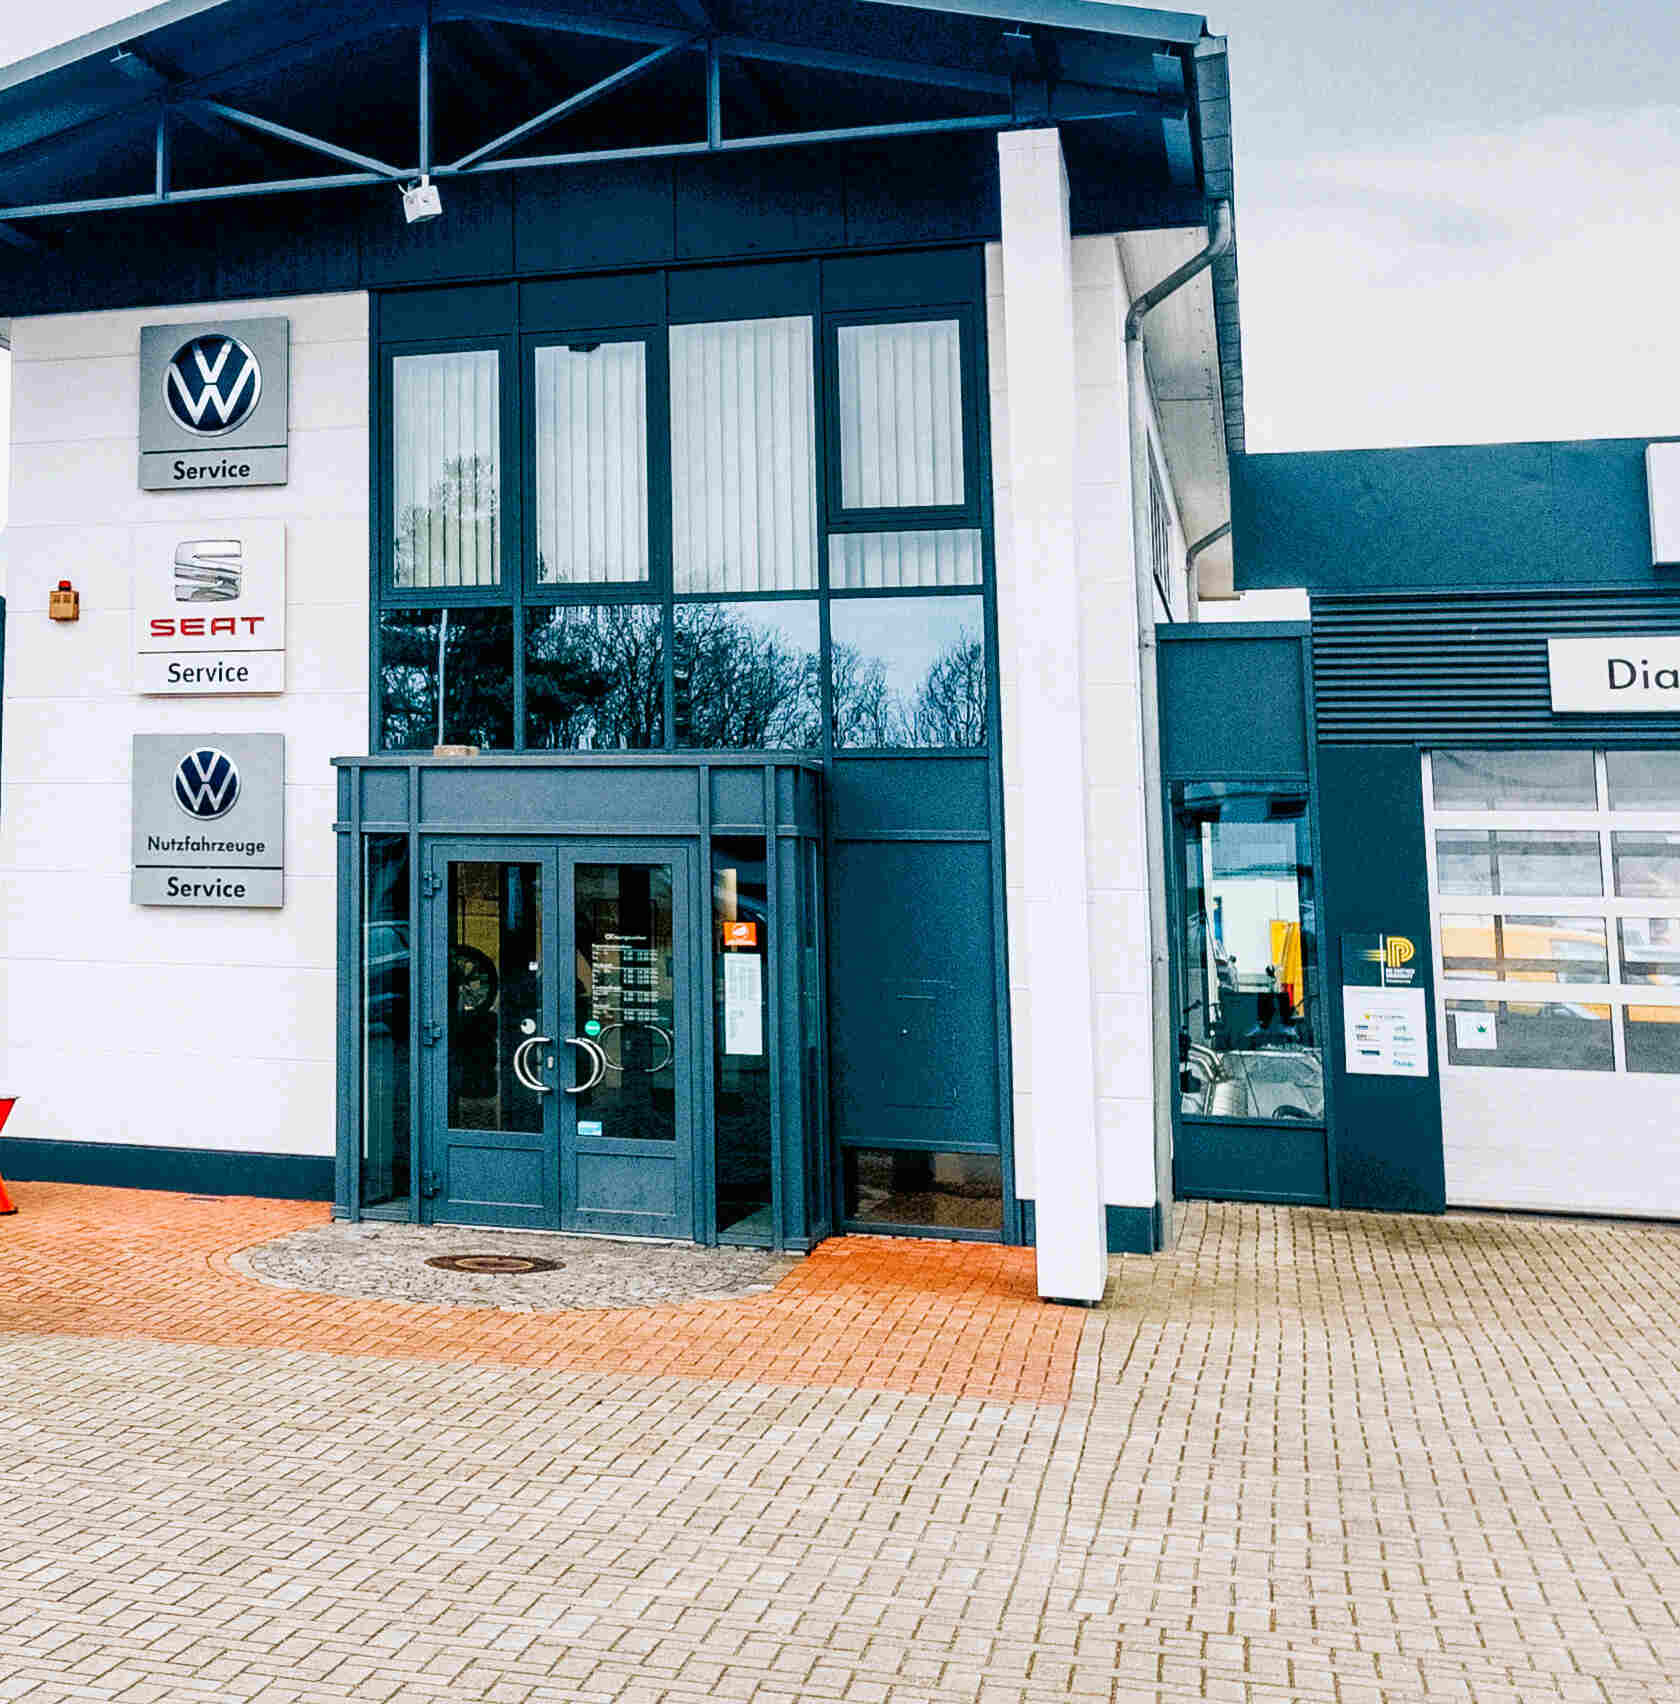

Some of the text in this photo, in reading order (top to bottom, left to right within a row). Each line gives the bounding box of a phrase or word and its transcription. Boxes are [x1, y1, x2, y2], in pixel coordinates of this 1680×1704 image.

[173, 459, 251, 480] Service
[150, 616, 265, 637] SEAT
[167, 661, 249, 683] Service
[147, 835, 266, 856] Nutzfahrzeuge
[166, 876, 246, 898] Service
